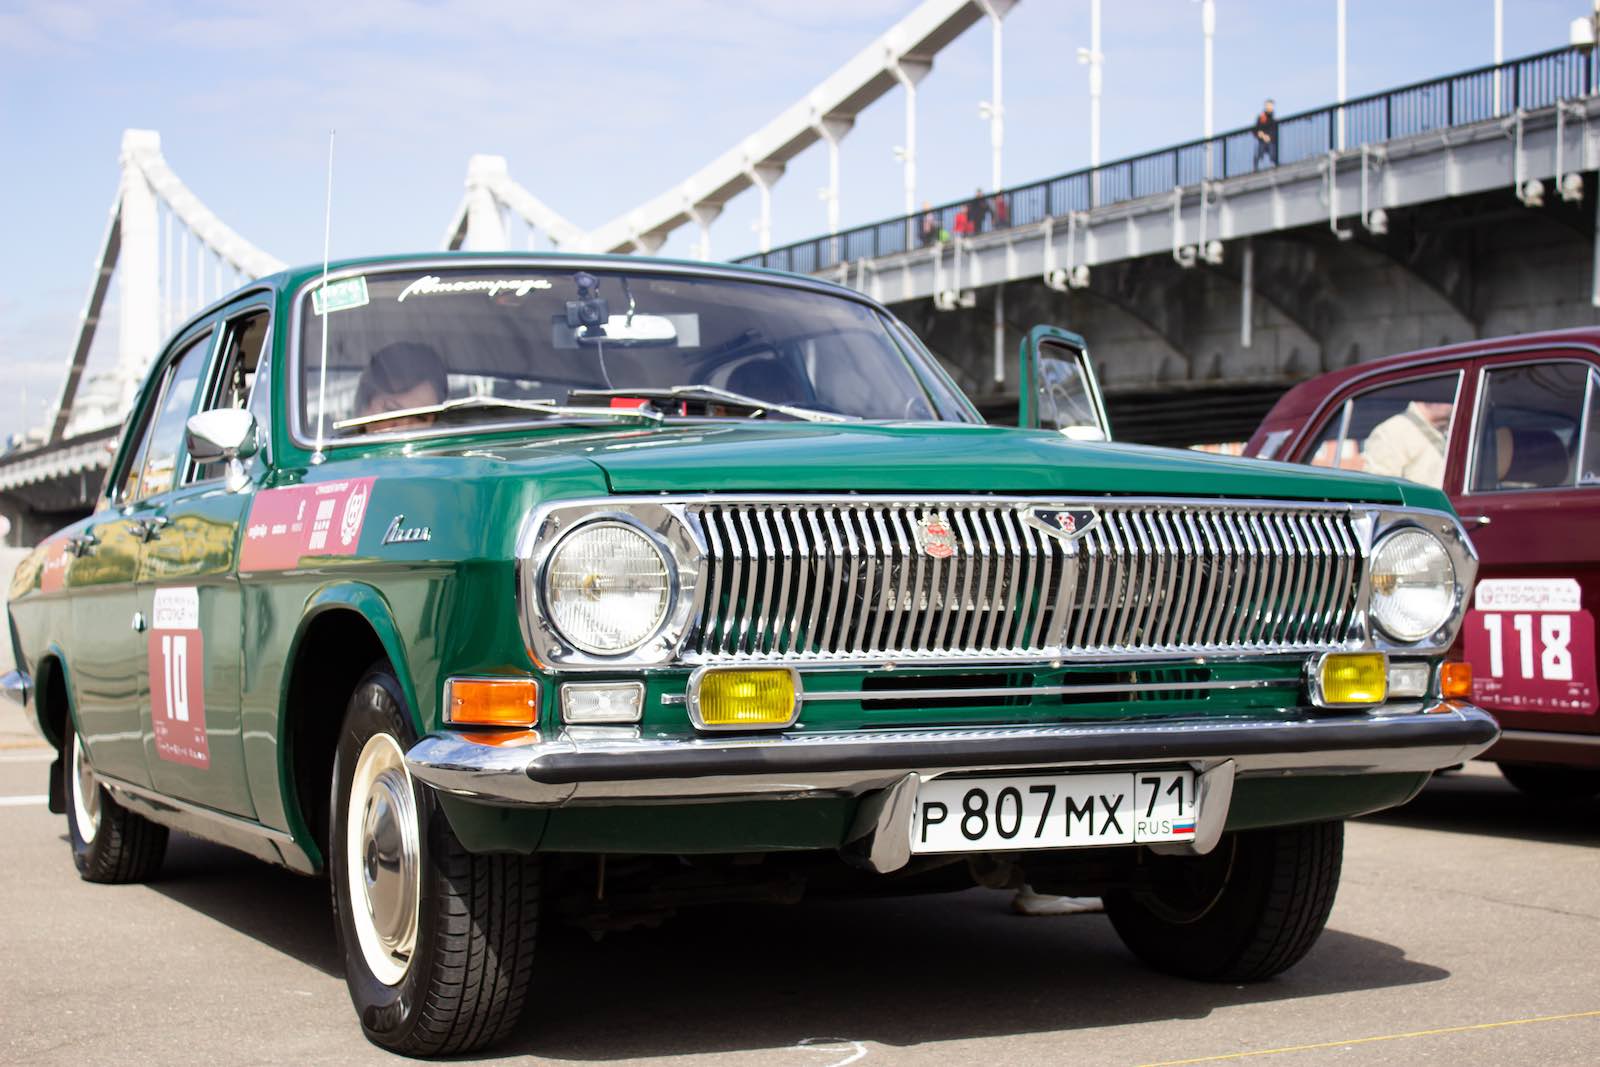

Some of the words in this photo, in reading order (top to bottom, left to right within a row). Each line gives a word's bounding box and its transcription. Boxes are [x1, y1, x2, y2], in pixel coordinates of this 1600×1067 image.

[1483, 613, 1573, 681] 118
[162, 635, 189, 722] 10
[960, 784, 1056, 841] 807
[1141, 776, 1184, 818] 71
[1137, 819, 1170, 835] RUS
